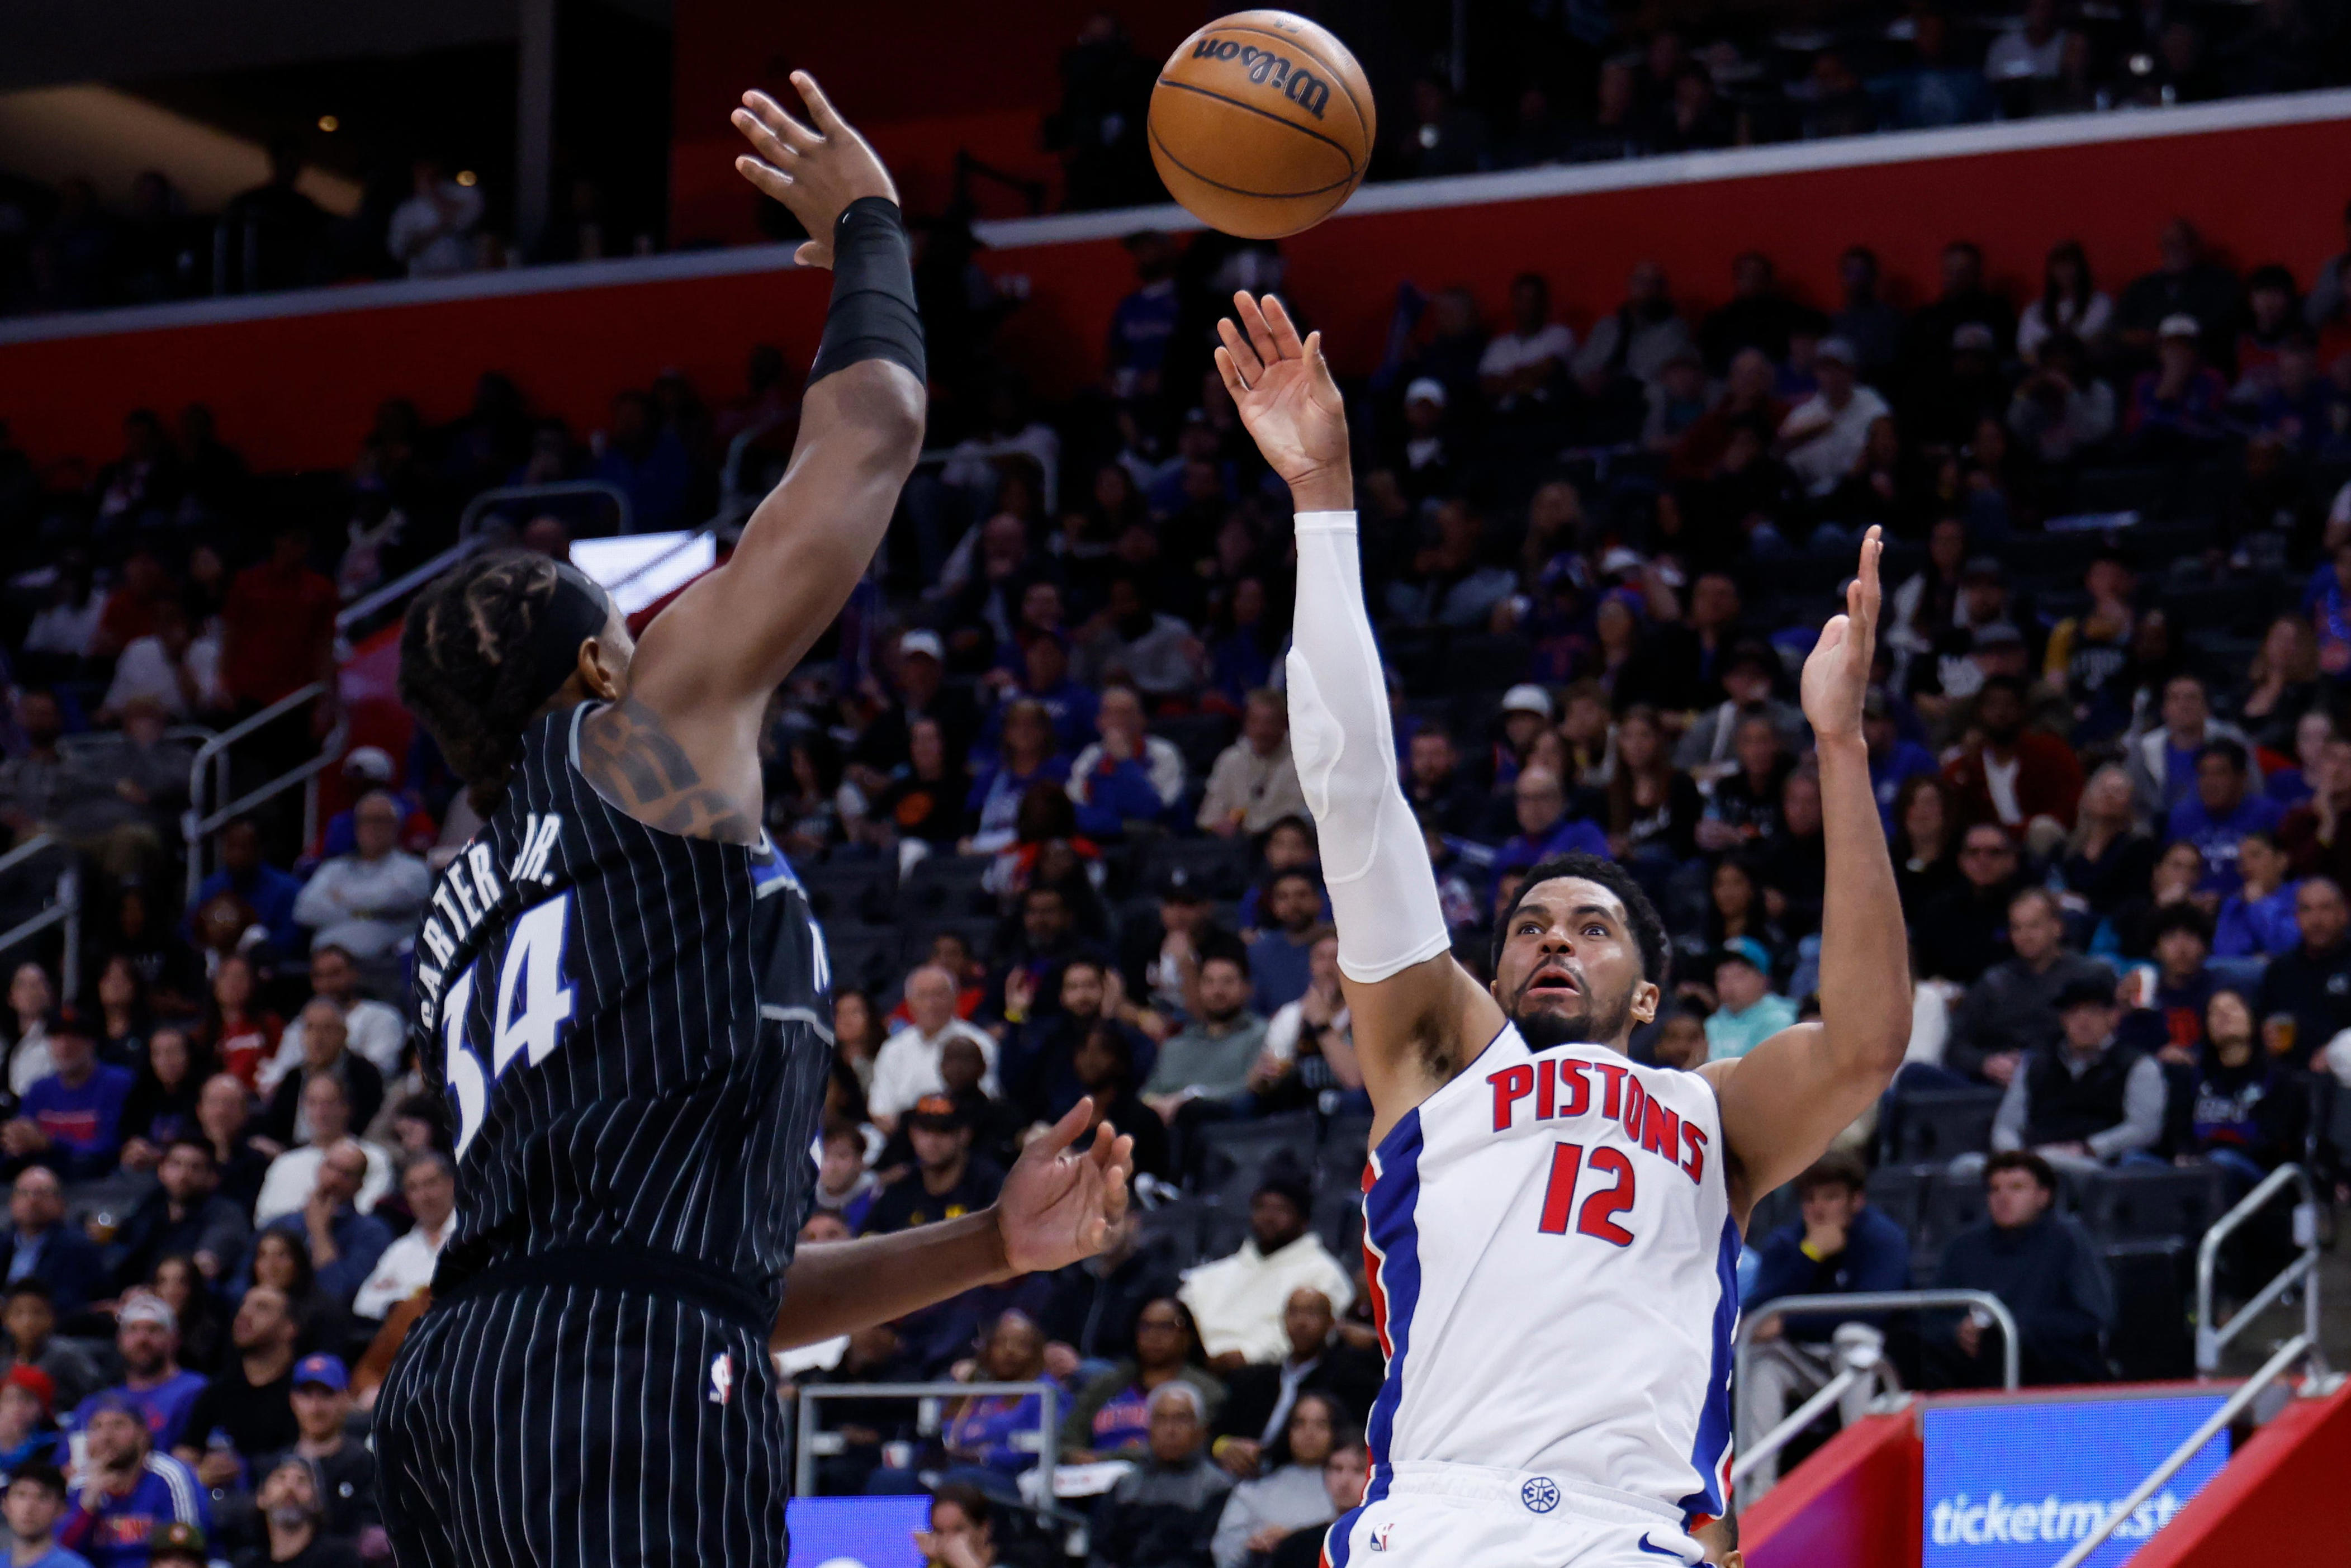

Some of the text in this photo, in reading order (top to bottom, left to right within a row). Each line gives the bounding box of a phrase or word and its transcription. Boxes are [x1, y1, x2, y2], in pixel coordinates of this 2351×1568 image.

[1192, 39, 1329, 120] Wilson
[418, 811, 561, 1034] CARTER JR.
[441, 889, 578, 1167] 34
[1486, 1058, 1708, 1186] PISTONS
[1538, 1141, 1636, 1248] 12
